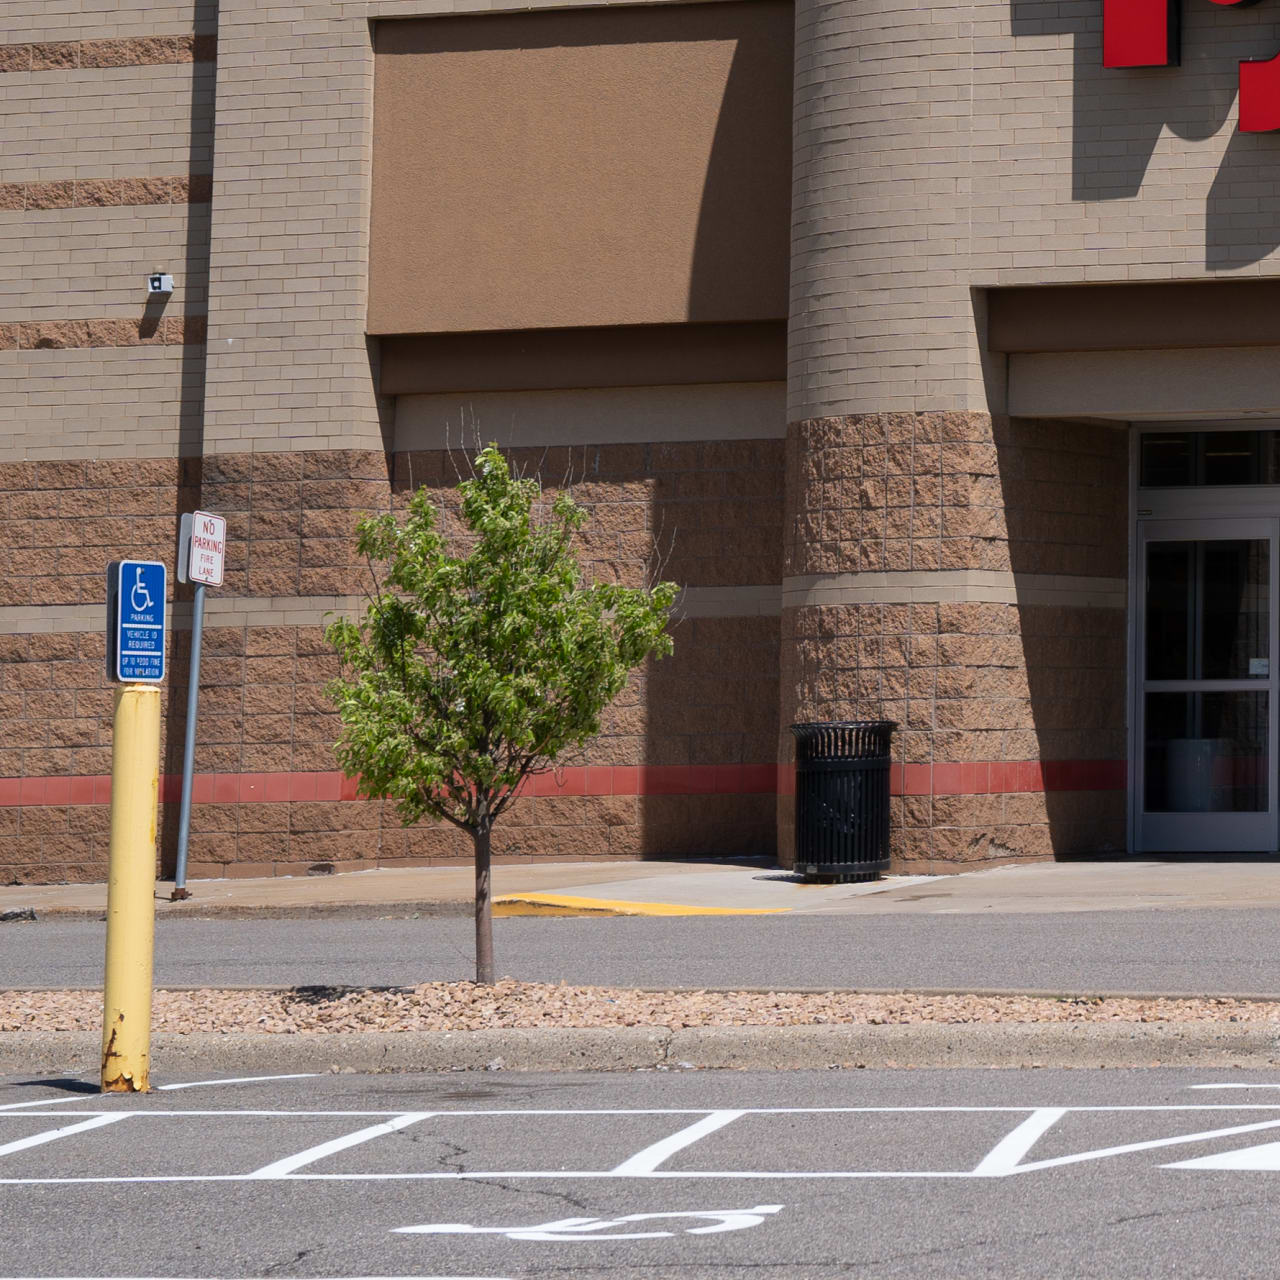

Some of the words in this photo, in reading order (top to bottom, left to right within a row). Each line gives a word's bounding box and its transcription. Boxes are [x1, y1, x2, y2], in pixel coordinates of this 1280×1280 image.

[203, 521, 215, 536] NO
[194, 535, 222, 554] PARKING
[200, 553, 214, 565] FIRE
[198, 566, 214, 577] LANE
[130, 613, 154, 622] PARKING
[126, 630, 150, 639] VEHICLE
[151, 631, 158, 639] ID
[127, 640, 155, 649] REQUIRED
[122, 657, 129, 666] UP
[130, 657, 136, 666] TO
[150, 658, 161, 667] FINE
[123, 667, 133, 676] FOR
